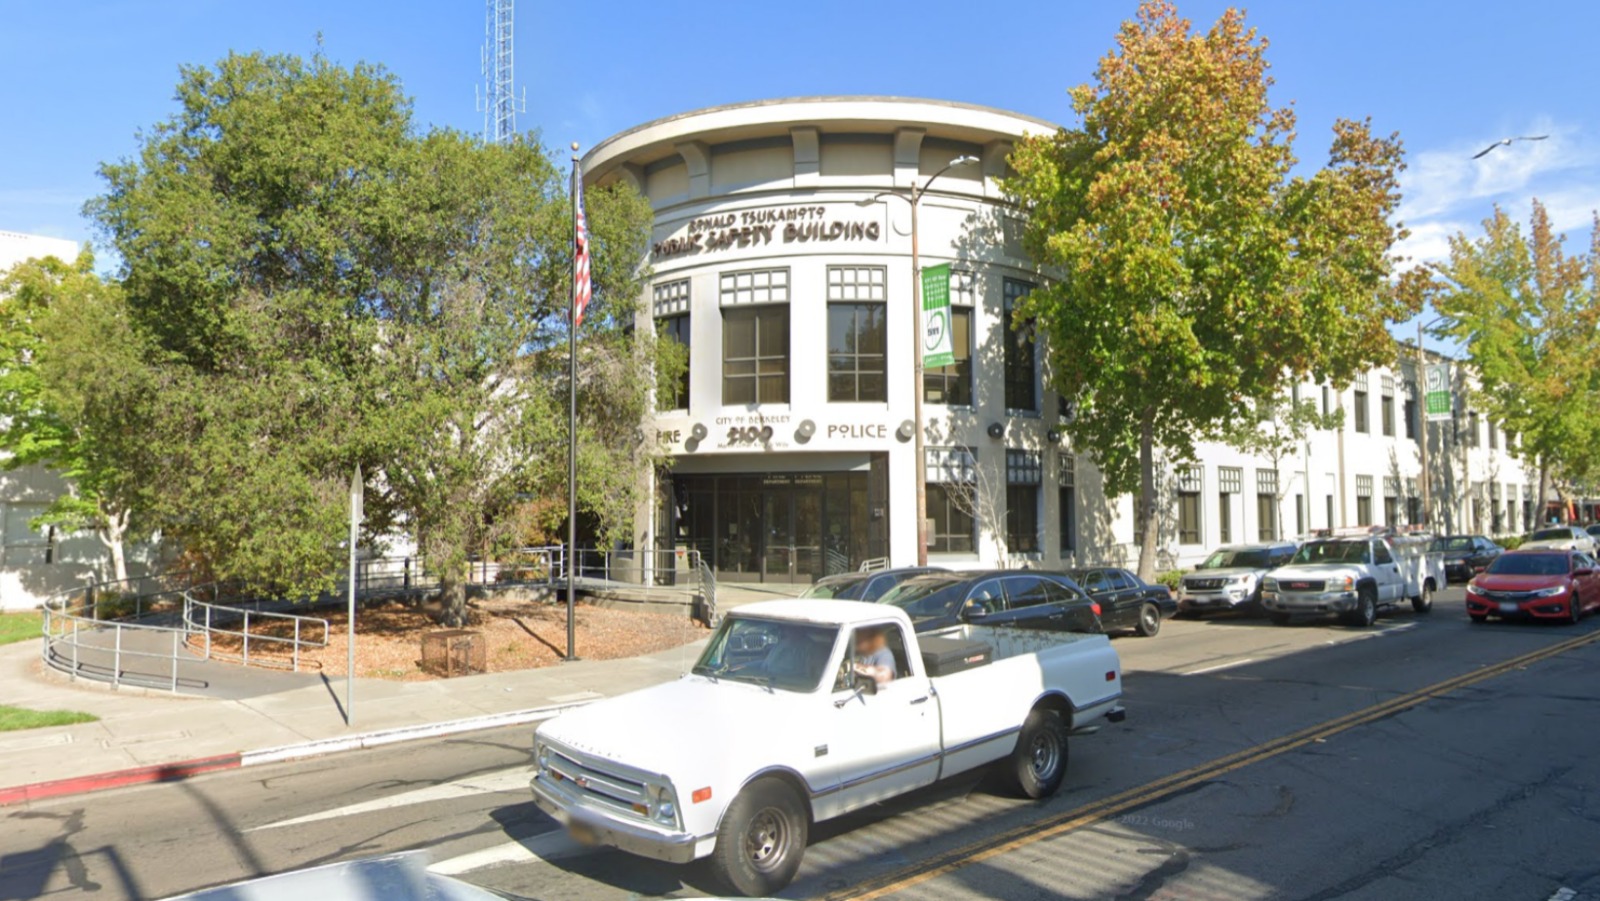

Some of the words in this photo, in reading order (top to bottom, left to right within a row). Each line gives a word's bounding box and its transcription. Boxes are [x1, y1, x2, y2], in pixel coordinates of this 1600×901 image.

[688, 214, 736, 233] RONALD
[741, 207, 826, 225] TSUKAMOTO
[706, 224, 776, 252] SAFETY
[783, 220, 880, 244] BUILDING
[715, 416, 732, 425] CITY
[735, 415, 745, 424] OF
[828, 423, 887, 439] POLICE
